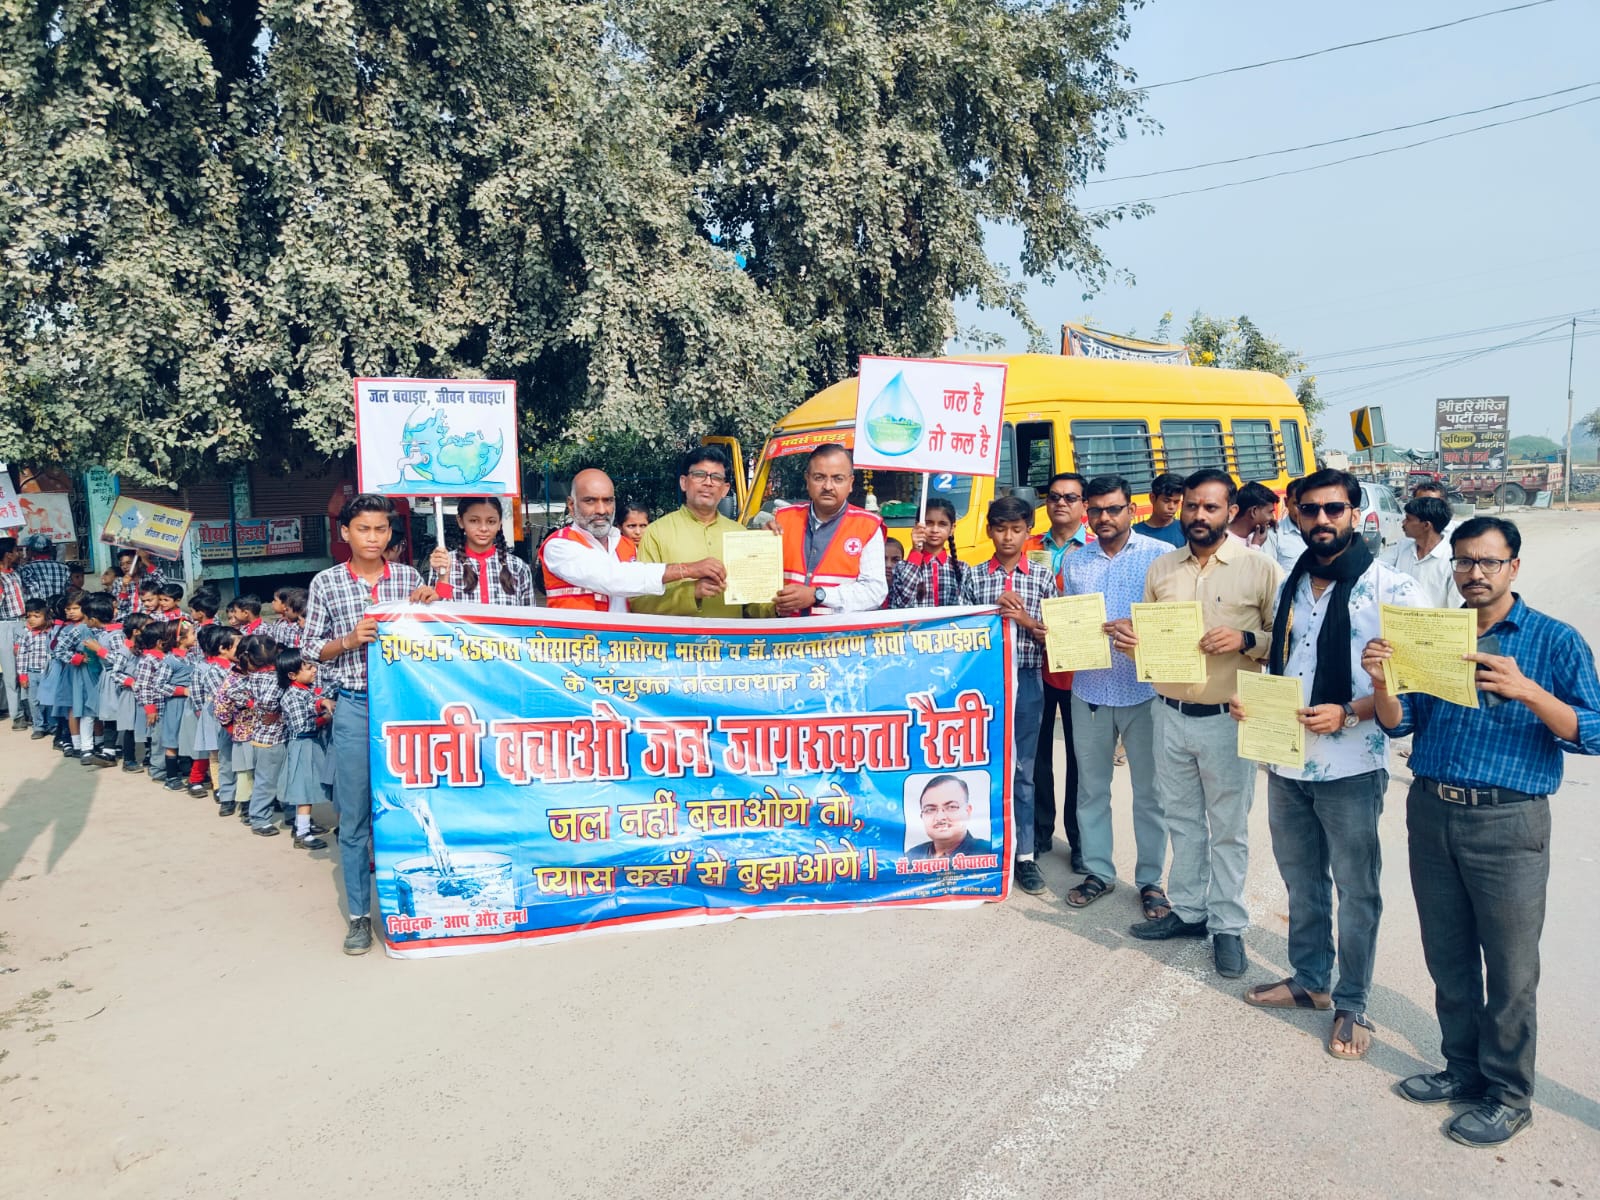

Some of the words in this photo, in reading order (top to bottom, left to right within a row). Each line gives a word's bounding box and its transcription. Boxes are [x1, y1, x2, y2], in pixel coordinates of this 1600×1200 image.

[368, 389, 389, 403] जल
[392, 389, 430, 406] बचाइए,
[435, 387, 464, 404] जीवन
[943, 389, 970, 412] जल
[972, 382, 985, 416] है
[928, 423, 947, 452] तो
[950, 431, 977, 455] कल
[979, 424, 991, 459] है
[938, 473, 953, 489] 2
[607, 636, 669, 663] आरोग्य
[675, 638, 723, 662] भारती
[728, 643, 743, 661] व
[871, 629, 906, 655] सेवा
[910, 622, 992, 654] फाउण्डेशन
[562, 670, 587, 693] के
[592, 667, 675, 702] संयुक्त
[806, 665, 831, 690] में
[383, 702, 485, 788] पानी
[490, 700, 631, 785] बचाओ
[637, 716, 713, 777] जन
[907, 689, 993, 769] रैली
[547, 805, 611, 842] जल
[617, 788, 680, 839] नहीं
[685, 784, 812, 832] बचाओगे
[817, 781, 865, 833] तो,
[532, 866, 618, 898] प्यास
[623, 849, 694, 887] कहाँ
[696, 847, 728, 887] से
[736, 837, 862, 894] बुझाओगे
[443, 914, 470, 929] आप
[475, 908, 499, 928] और
